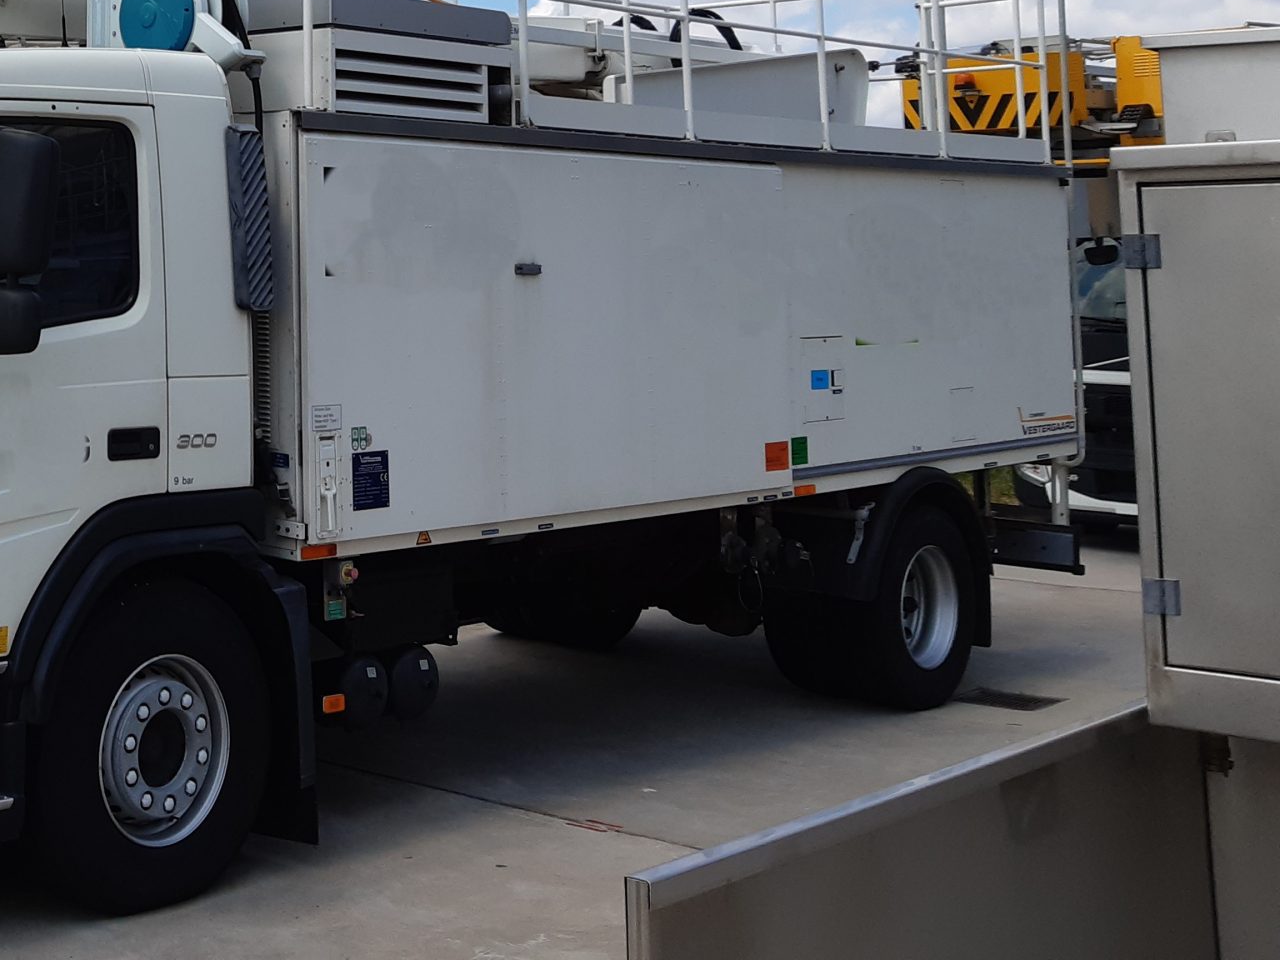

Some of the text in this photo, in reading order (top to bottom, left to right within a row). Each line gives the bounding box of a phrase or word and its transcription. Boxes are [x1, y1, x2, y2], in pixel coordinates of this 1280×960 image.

[1021, 421, 1076, 436] VESTERGAARD
[176, 433, 217, 449] 300
[173, 476, 194, 486] 9 bar
